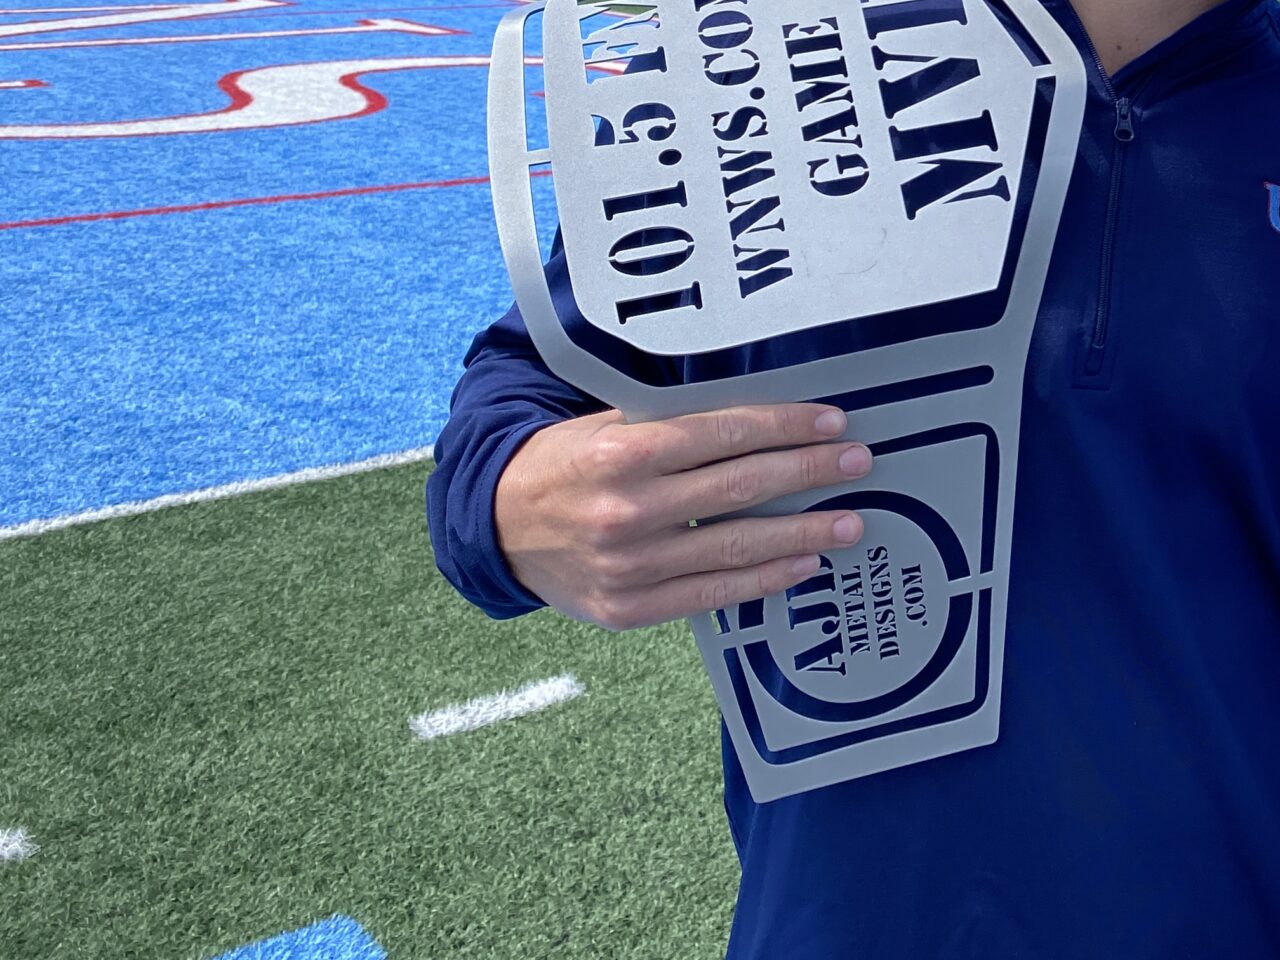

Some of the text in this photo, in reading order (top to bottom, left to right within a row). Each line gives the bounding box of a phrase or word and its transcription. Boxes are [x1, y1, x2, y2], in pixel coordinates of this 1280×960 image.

[781, 16, 870, 198] GAME
[590, 101, 704, 325] 101.5
[841, 565, 871, 656] METAL
[867, 545, 900, 660] DESIGNS
[901, 564, 928, 627] .COM
